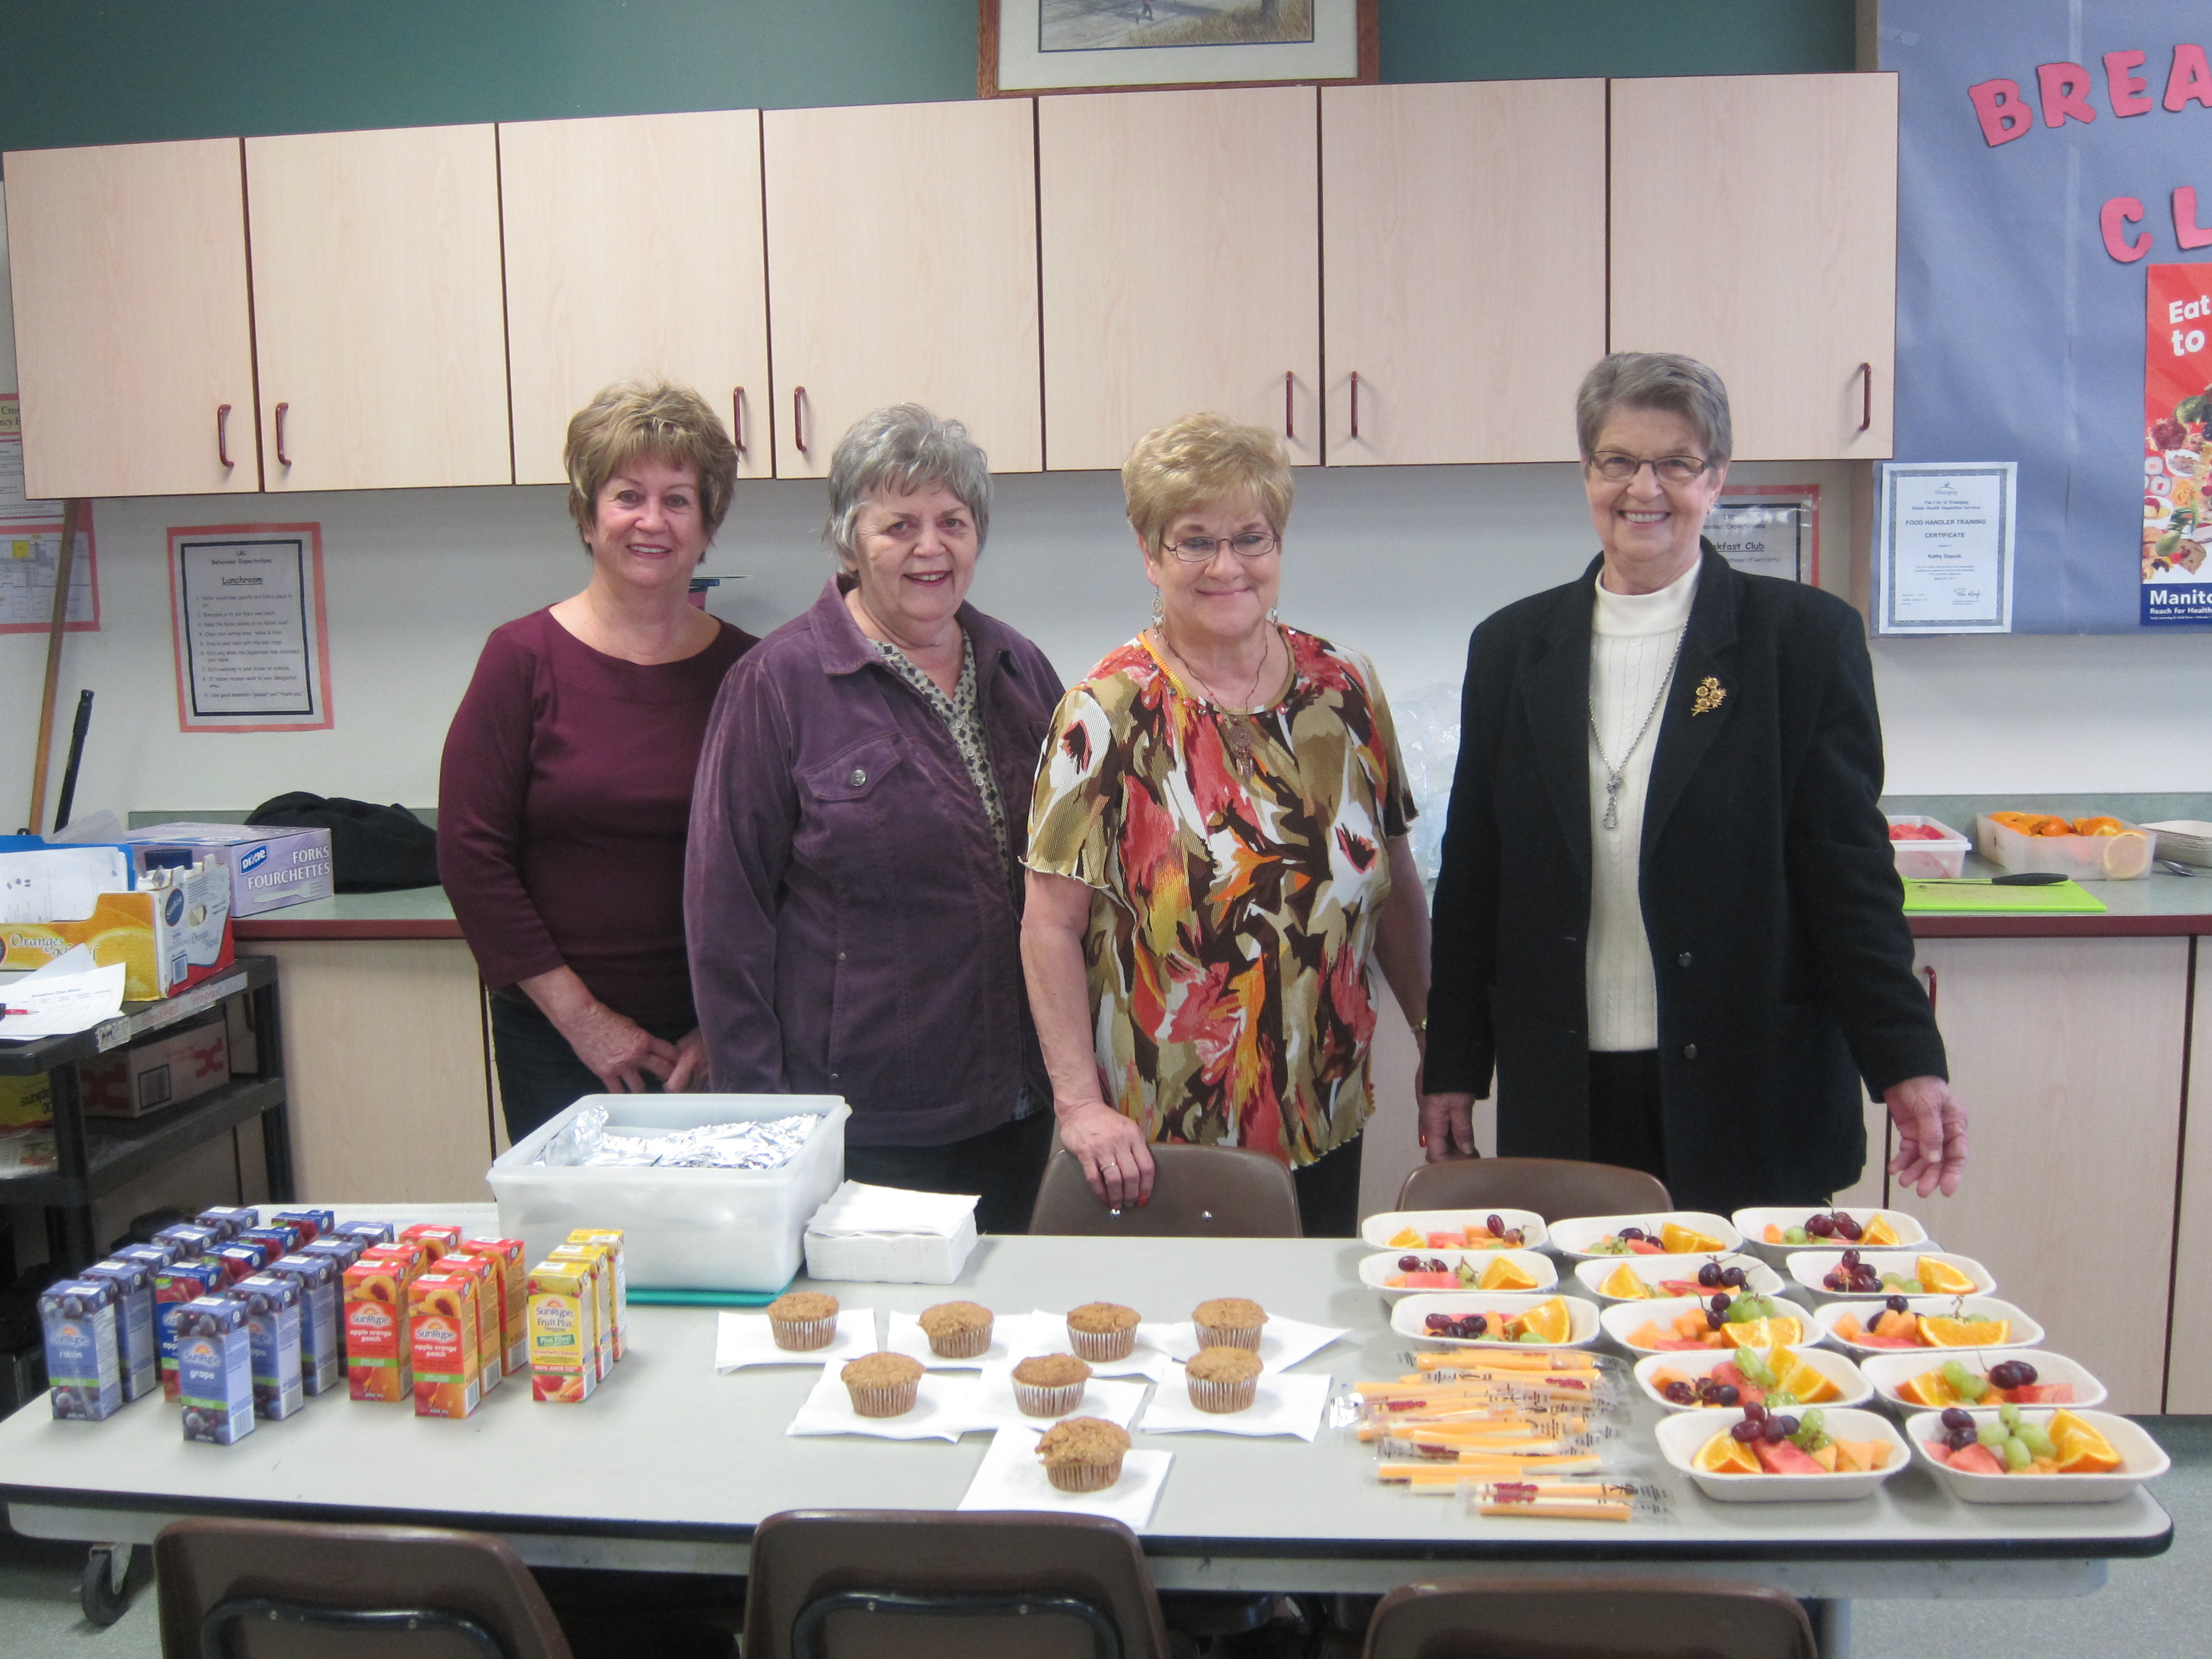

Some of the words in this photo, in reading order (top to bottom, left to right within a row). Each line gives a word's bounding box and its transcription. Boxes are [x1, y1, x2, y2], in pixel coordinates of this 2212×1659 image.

[1968, 44, 2212, 147] BREA
[2100, 186, 2212, 263] CL
[2169, 295, 2210, 324] Eat
[2171, 329, 2205, 357] to
[292, 846, 329, 864] FORKS
[247, 861, 330, 890] FOURCHETTES
[12, 933, 65, 952] Oranges
[352, 1315, 390, 1326] SunRype
[536, 1307, 573, 1322] SunRype
[537, 1318, 555, 1326] Fruit
[557, 1319, 572, 1328] Plus
[417, 1329, 454, 1341] SunRype
[59, 1350, 82, 1359] raisin
[414, 1344, 433, 1352] apple
[434, 1344, 457, 1353] orange
[184, 1352, 220, 1368] SunRype
[189, 1370, 215, 1380] grape
